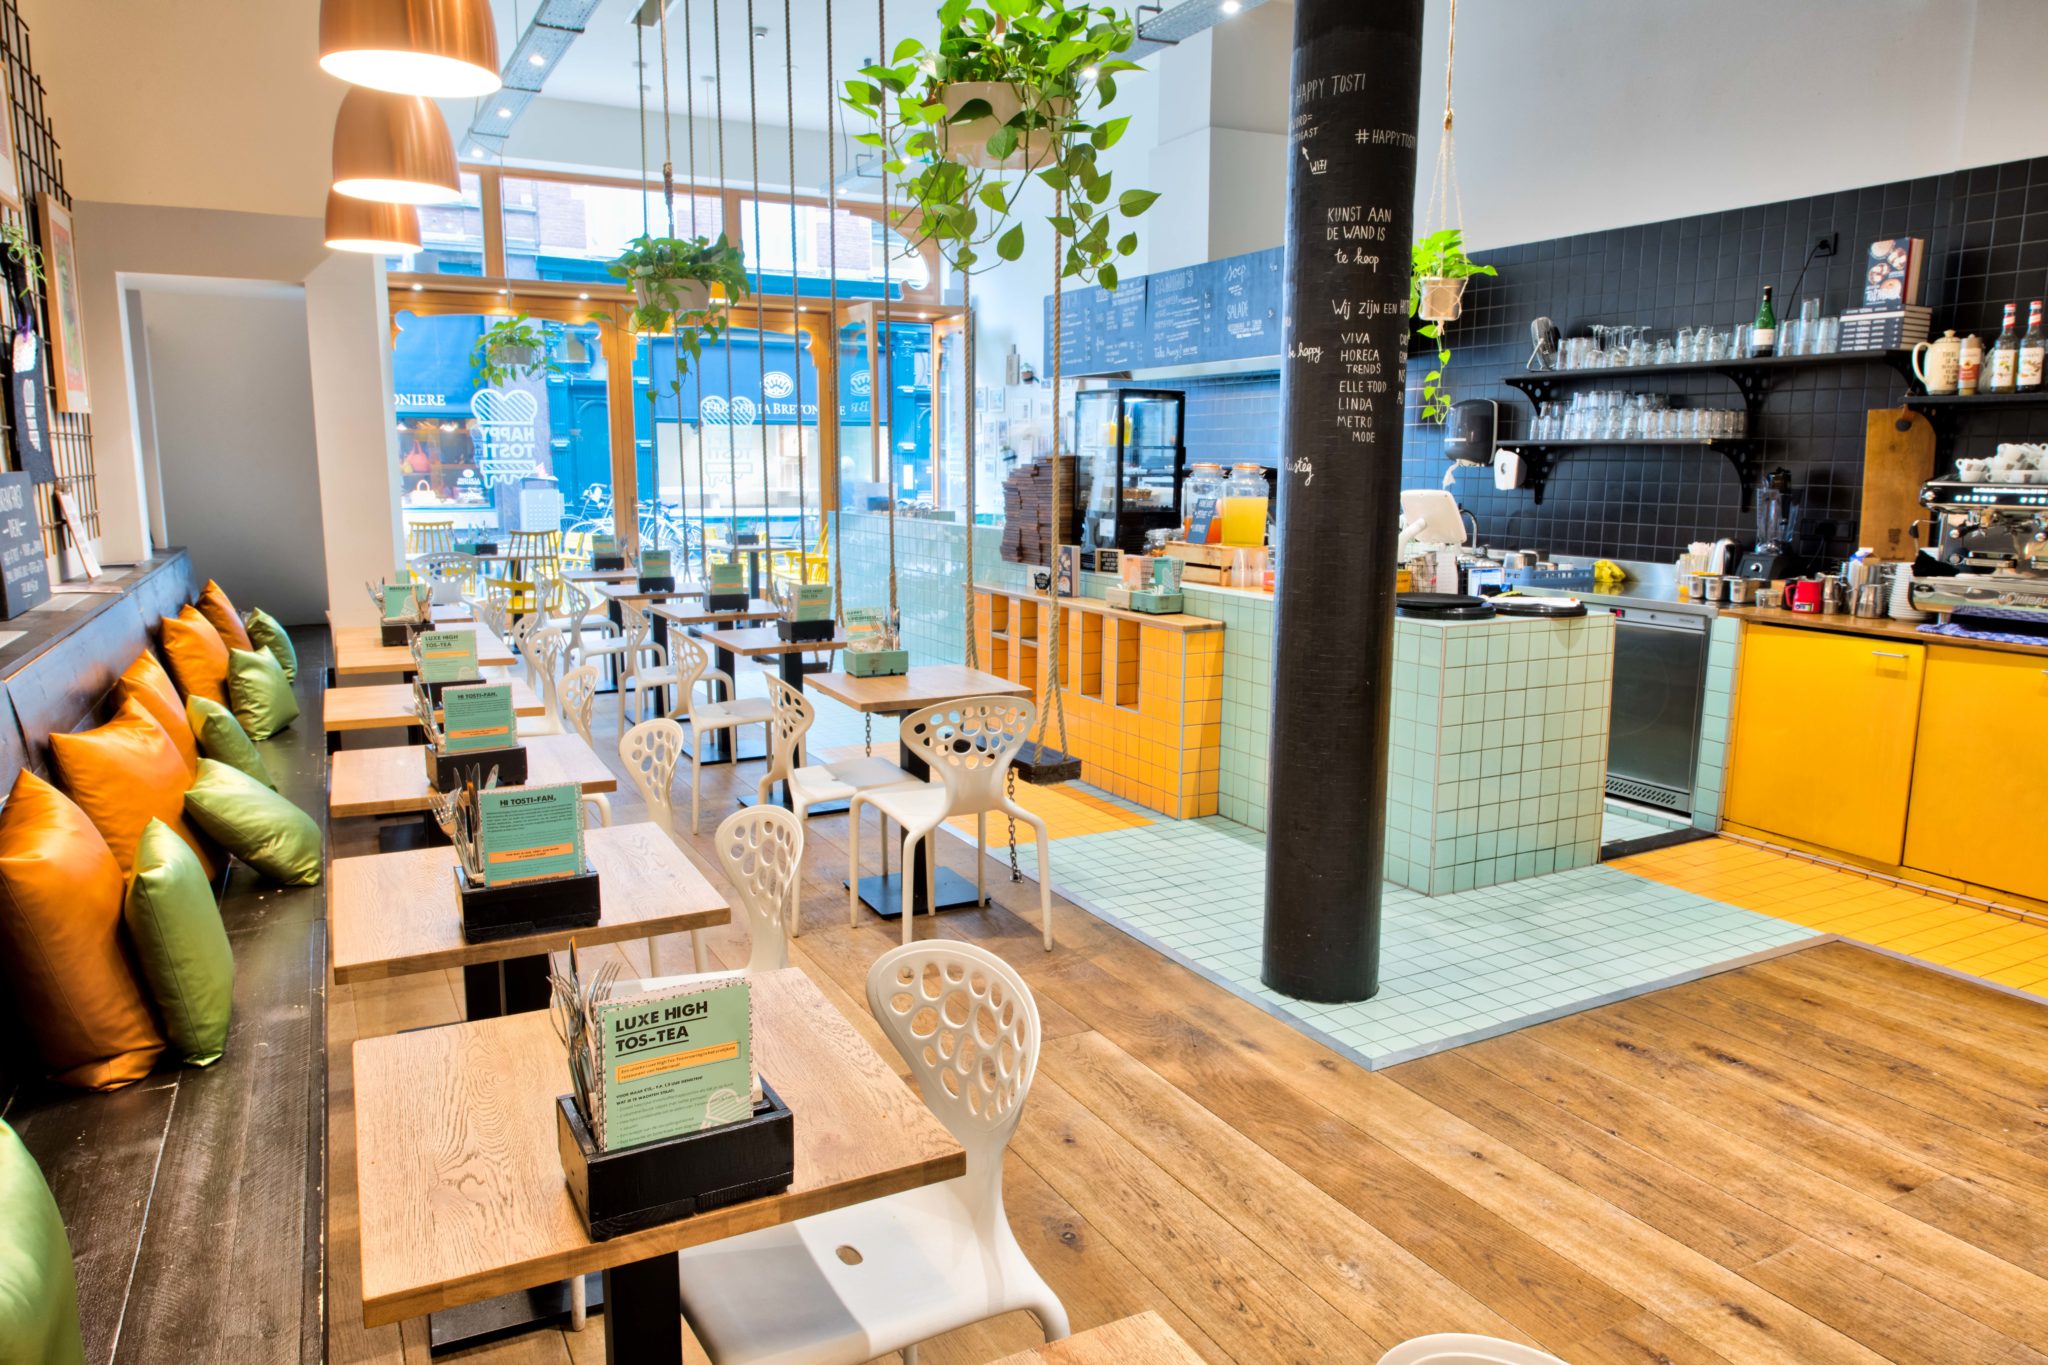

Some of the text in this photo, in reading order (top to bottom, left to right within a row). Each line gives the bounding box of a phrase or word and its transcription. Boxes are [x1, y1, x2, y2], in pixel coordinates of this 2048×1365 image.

[1296, 73, 1366, 106] HAPPY TOSTI
[1310, 159, 1328, 173] WIFI
[1327, 205, 1392, 223] KUNST AAN
[1327, 225, 1386, 242] DE WAND IS
[1334, 247, 1380, 274] te koop
[1383, 303, 1398, 314] EEN
[1341, 332, 1370, 345] VIVA
[1297, 341, 1324, 364] happy
[1340, 348, 1380, 363] HORECA
[1346, 363, 1381, 375] TRENDS
[1339, 380, 1387, 393] ELLE FOOD
[1338, 397, 1373, 411] LINDA
[1337, 415, 1372, 429] METRO
[1352, 431, 1376, 443] MODE
[500, 799, 508, 807] HI
[615, 1000, 708, 1033] LUXE HIGH
[615, 1025, 689, 1052] TOS-TEA
